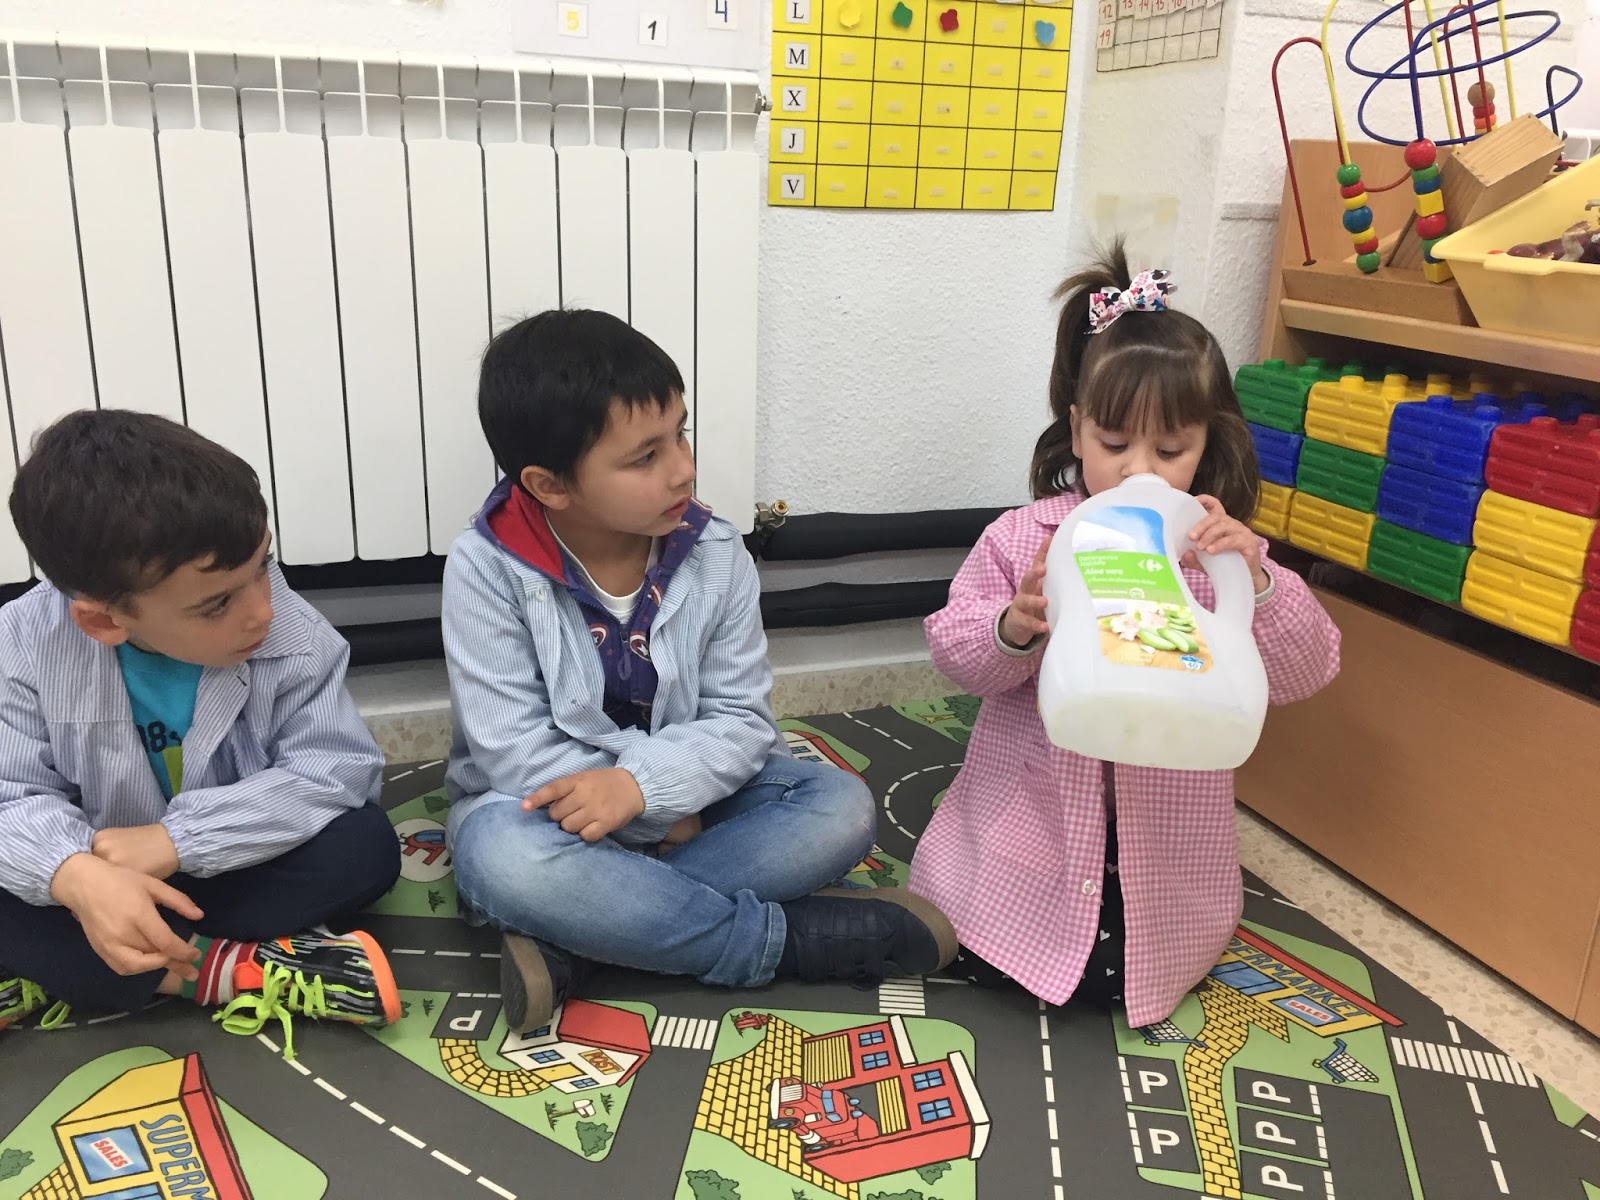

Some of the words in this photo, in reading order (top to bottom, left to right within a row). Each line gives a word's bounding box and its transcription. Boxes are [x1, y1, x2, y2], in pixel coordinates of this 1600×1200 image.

[566, 10, 580, 31] 5
[715, 0, 728, 23] 4
[792, 2, 805, 19] L
[1102, 4, 1113, 19] 12
[648, 20, 657, 40] 1
[1100, 29, 1111, 47] 19
[788, 48, 806, 65] M
[788, 90, 801, 107] X
[788, 133, 797, 149] J
[787, 179, 800, 195] V
[449, 1009, 482, 1031] P
[1287, 1000, 1331, 1021] SALES
[584, 1051, 621, 1072] POST
[1139, 1070, 1168, 1094] P
[1252, 1080, 1291, 1103] P
[1148, 1128, 1180, 1154] P
[1255, 1121, 1296, 1145] P
[94, 1140, 128, 1168] SALES
[1261, 1165, 1304, 1192] P
